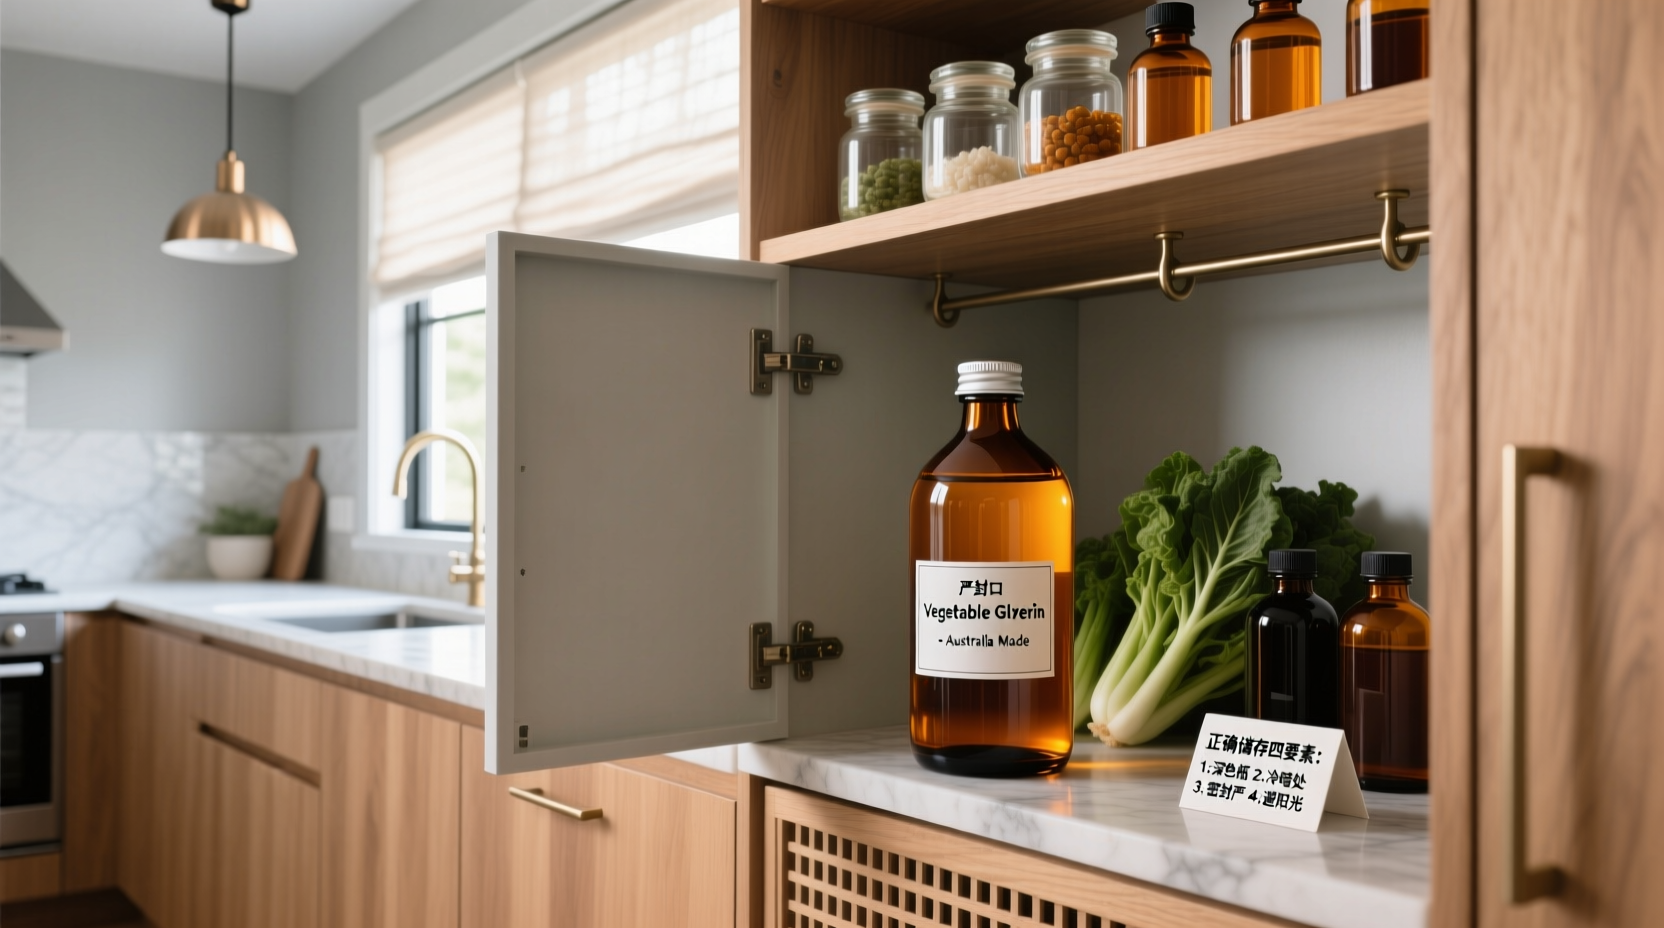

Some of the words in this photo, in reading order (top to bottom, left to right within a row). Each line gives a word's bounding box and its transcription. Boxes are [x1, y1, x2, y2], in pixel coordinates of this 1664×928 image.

[923, 602, 991, 623] Vegetable
[994, 602, 1045, 620] Glyerin
[998, 634, 1030, 647] Made
